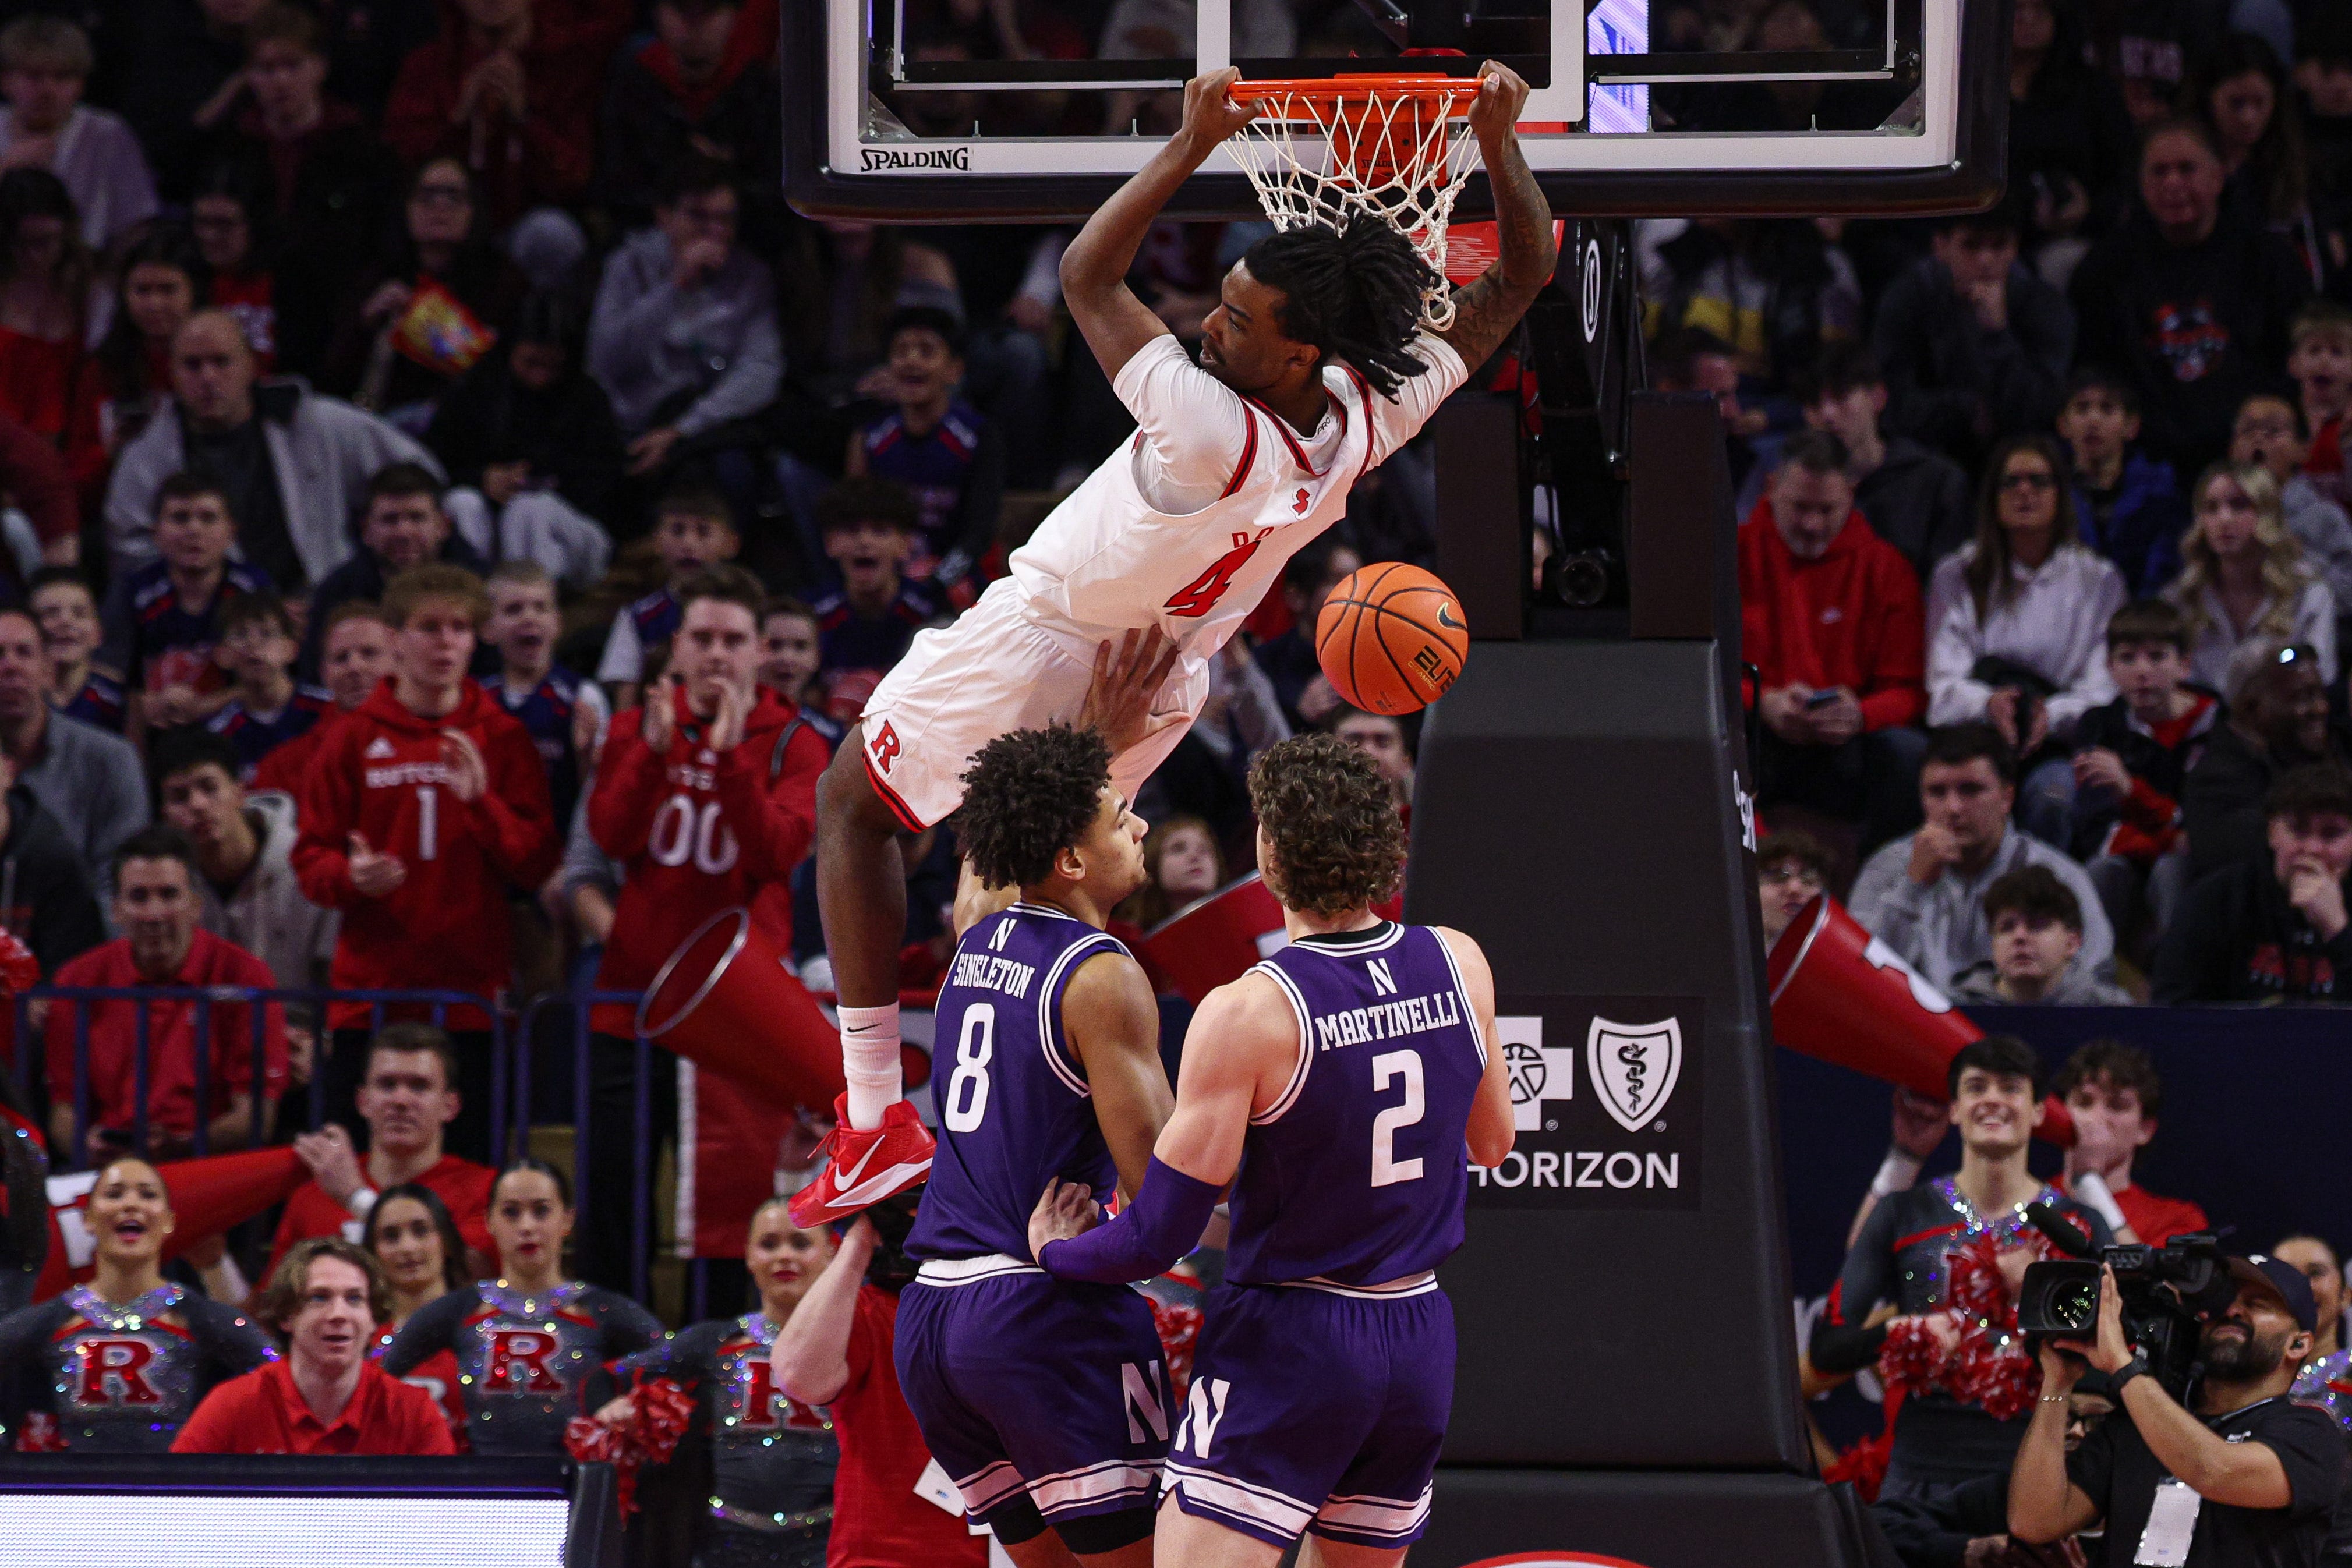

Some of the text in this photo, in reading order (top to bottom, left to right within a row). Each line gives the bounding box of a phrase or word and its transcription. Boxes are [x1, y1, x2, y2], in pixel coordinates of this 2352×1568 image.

[861, 147, 968, 172] SPALDING
[1317, 417, 1331, 436] PRO
[1162, 540, 1261, 617] 4
[870, 718, 901, 775] R
[416, 785, 438, 861] 1
[648, 792, 740, 875] 00
[987, 918, 1017, 953] N
[952, 953, 1035, 999] SINGLETON
[1366, 957, 1398, 997] N
[1315, 990, 1460, 1052] MARTINELLI
[945, 1002, 995, 1133] 8
[1371, 1049, 1426, 1188] 2
[77, 1337, 163, 1405] R
[481, 1328, 563, 1392] R
[1120, 1359, 1169, 1445] N
[1174, 1375, 1231, 1459] N
